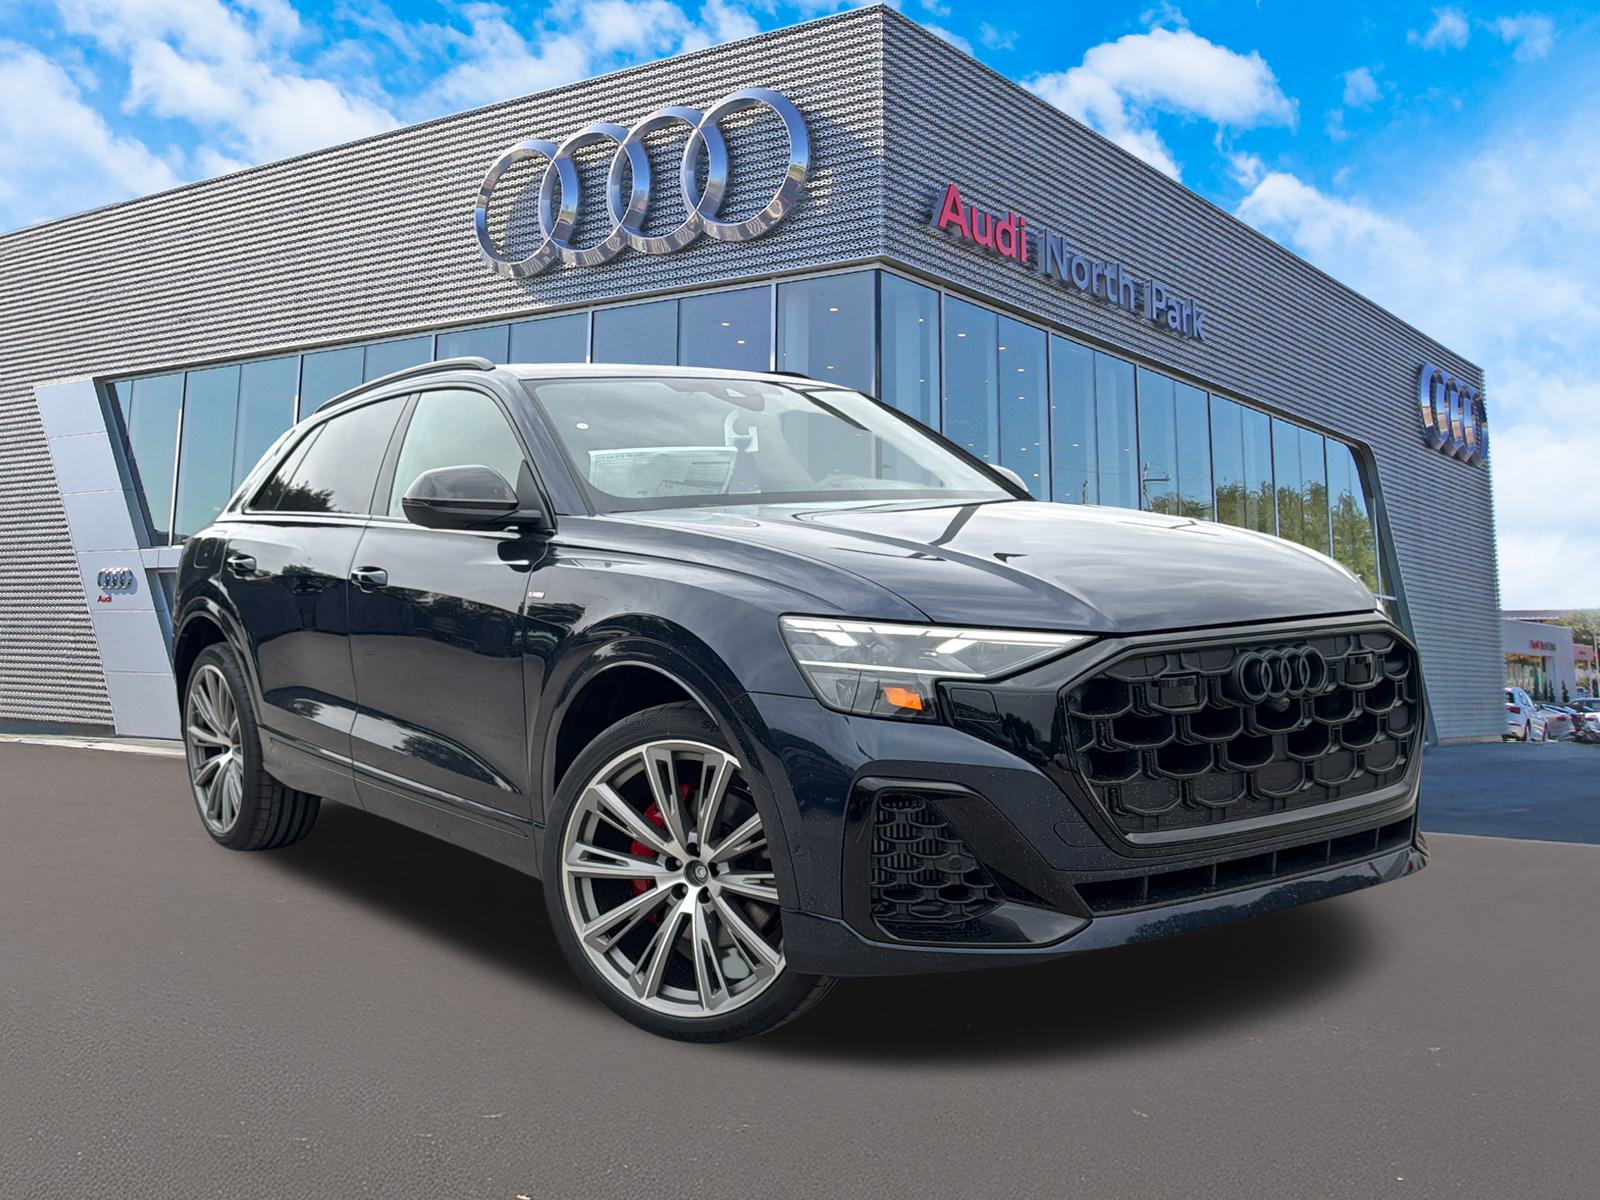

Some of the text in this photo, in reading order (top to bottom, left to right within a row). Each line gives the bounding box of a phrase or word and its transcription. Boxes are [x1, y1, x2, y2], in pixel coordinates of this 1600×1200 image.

[934, 183, 1207, 342] Audi North Park
